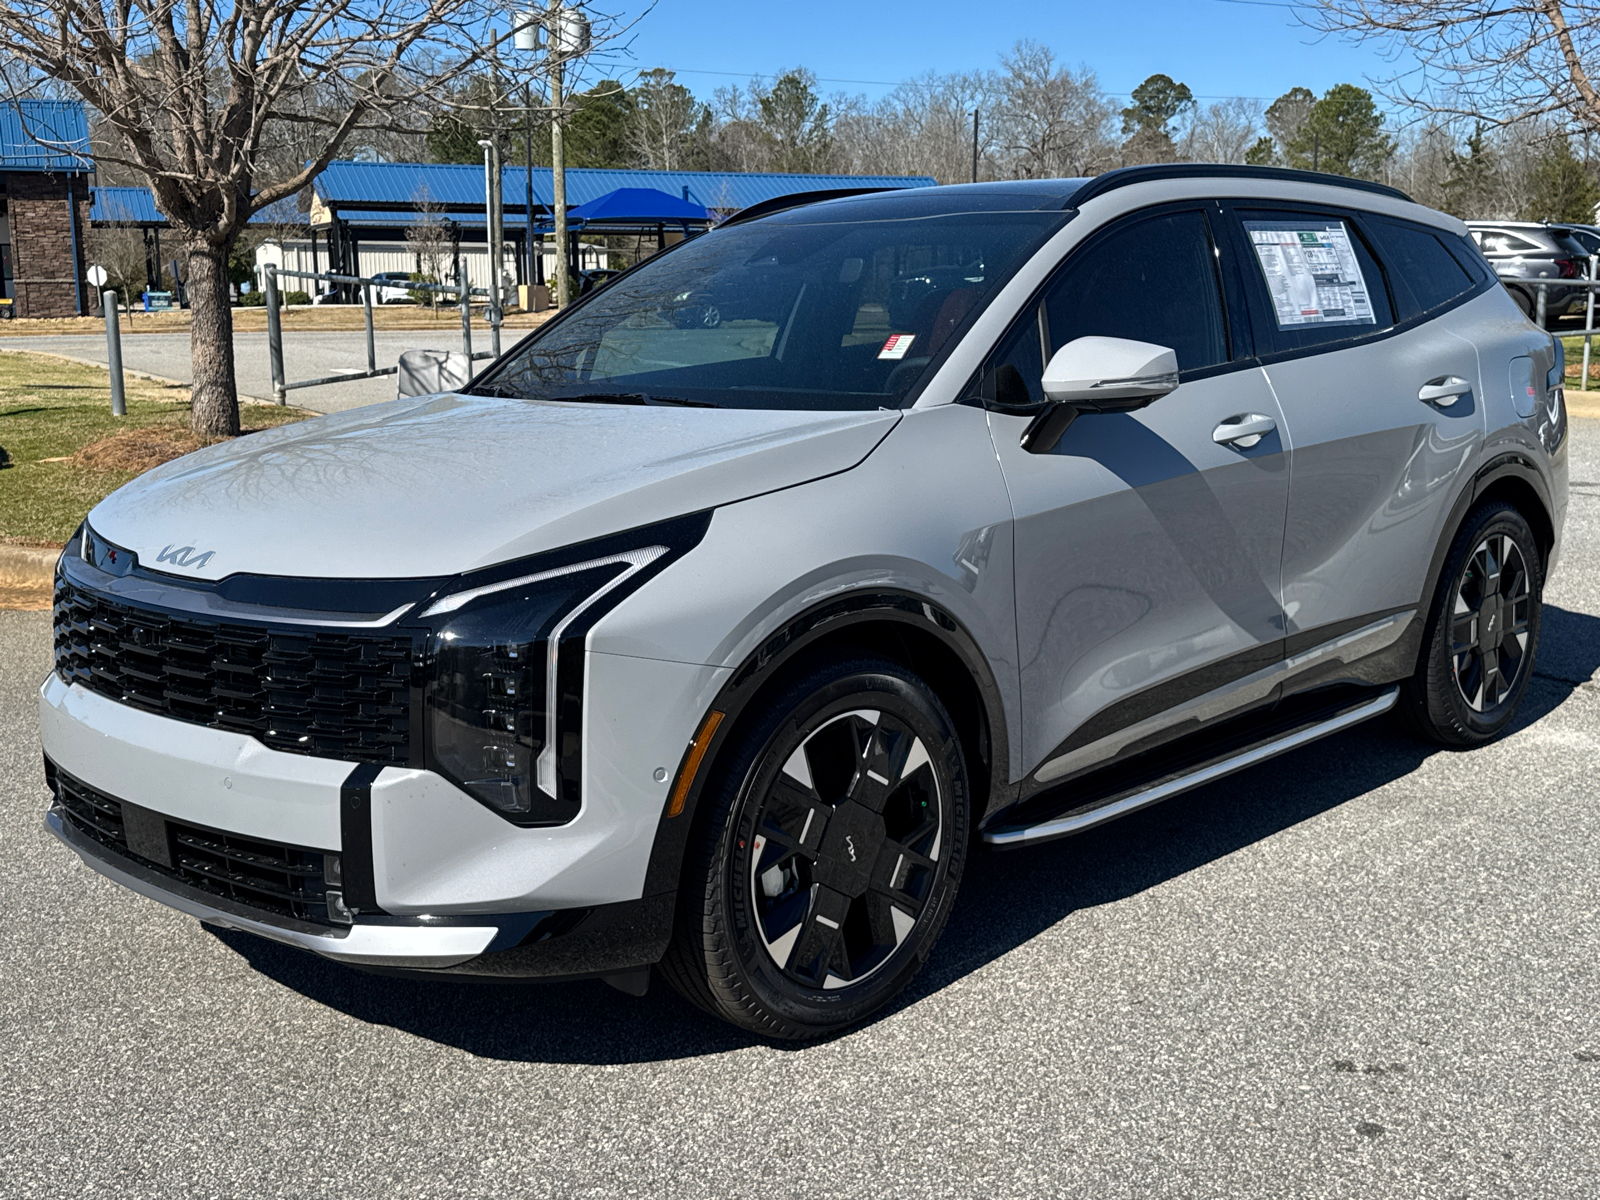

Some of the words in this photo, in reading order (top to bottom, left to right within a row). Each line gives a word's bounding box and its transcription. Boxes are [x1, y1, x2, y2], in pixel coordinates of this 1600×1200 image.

[156, 543, 216, 570] KIA
[748, 748, 778, 803] PRIMACY
[948, 779, 965, 875] MICHELIN
